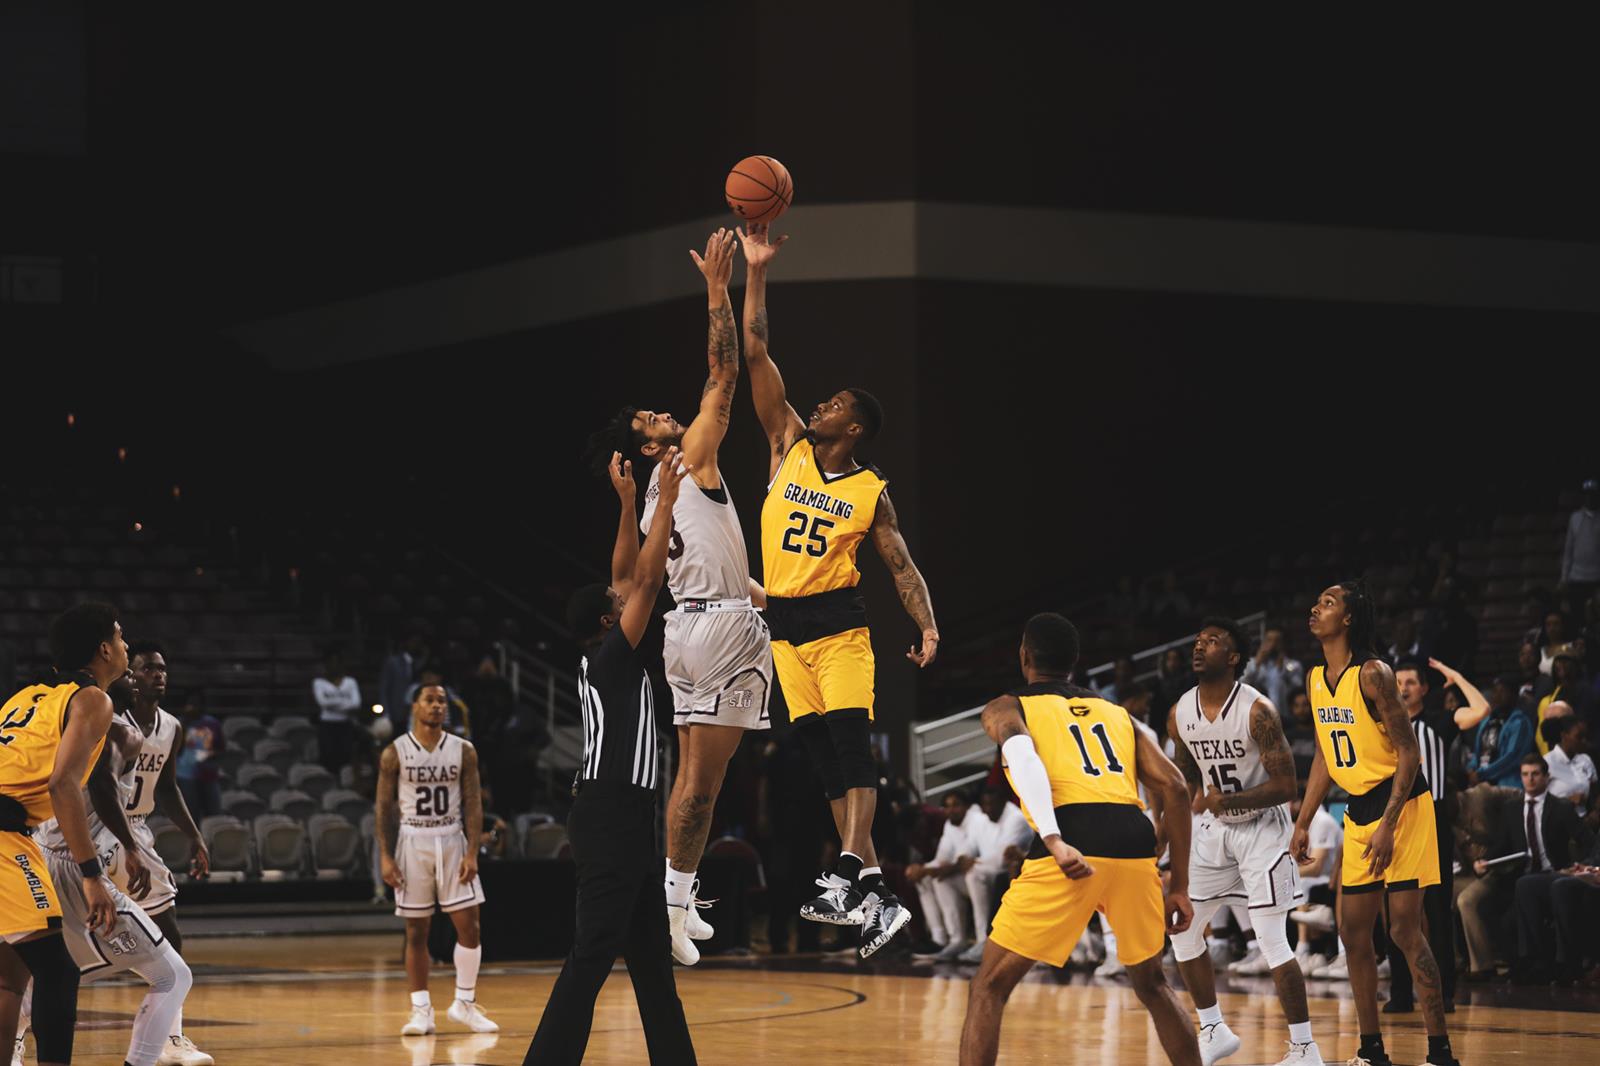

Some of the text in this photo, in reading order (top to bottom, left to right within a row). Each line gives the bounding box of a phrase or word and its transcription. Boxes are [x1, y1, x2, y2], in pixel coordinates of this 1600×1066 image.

[784, 482, 854, 520] GRAMBLING
[781, 510, 835, 557] 25
[1069, 723, 1123, 776] 11
[1190, 739, 1246, 760] TEXAS
[1330, 729, 1357, 768] 10
[405, 765, 458, 782] TEXAS
[1208, 763, 1243, 794] 15
[415, 785, 449, 816] 20
[15, 853, 50, 910] GRAMBLING
